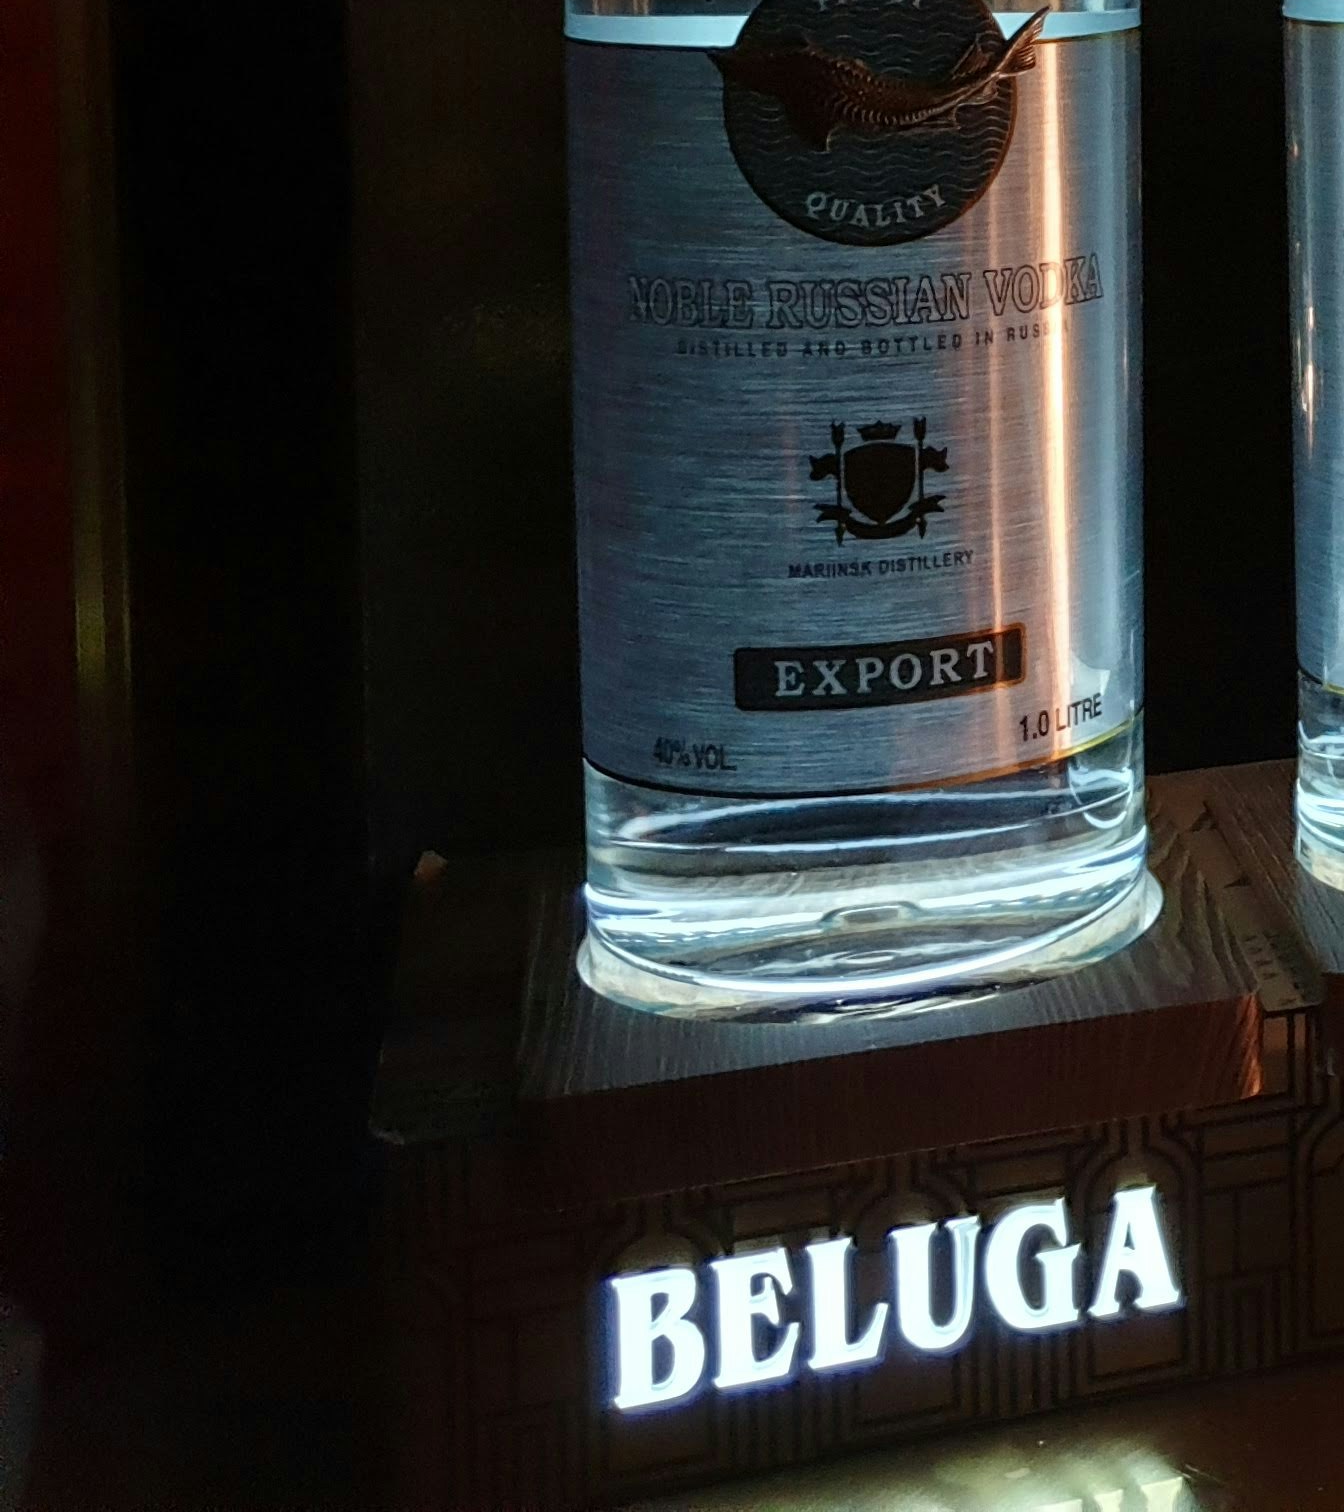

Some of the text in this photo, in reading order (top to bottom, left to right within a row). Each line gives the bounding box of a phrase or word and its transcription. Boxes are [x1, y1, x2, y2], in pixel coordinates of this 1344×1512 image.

[806, 184, 949, 228] QUALITY
[628, 253, 1105, 329] NOBLE RUSSIAN VODKA
[677, 339, 788, 358] DISTILLED
[803, 339, 846, 357] AND
[861, 334, 962, 356] BOTTLED
[975, 330, 994, 346] IN
[787, 550, 975, 579] MARIINSK DISTILLERY
[774, 639, 997, 699] EXPORT
[1019, 691, 1104, 741] 1.0 LITRE
[610, 1183, 1183, 1412] BELUGA
